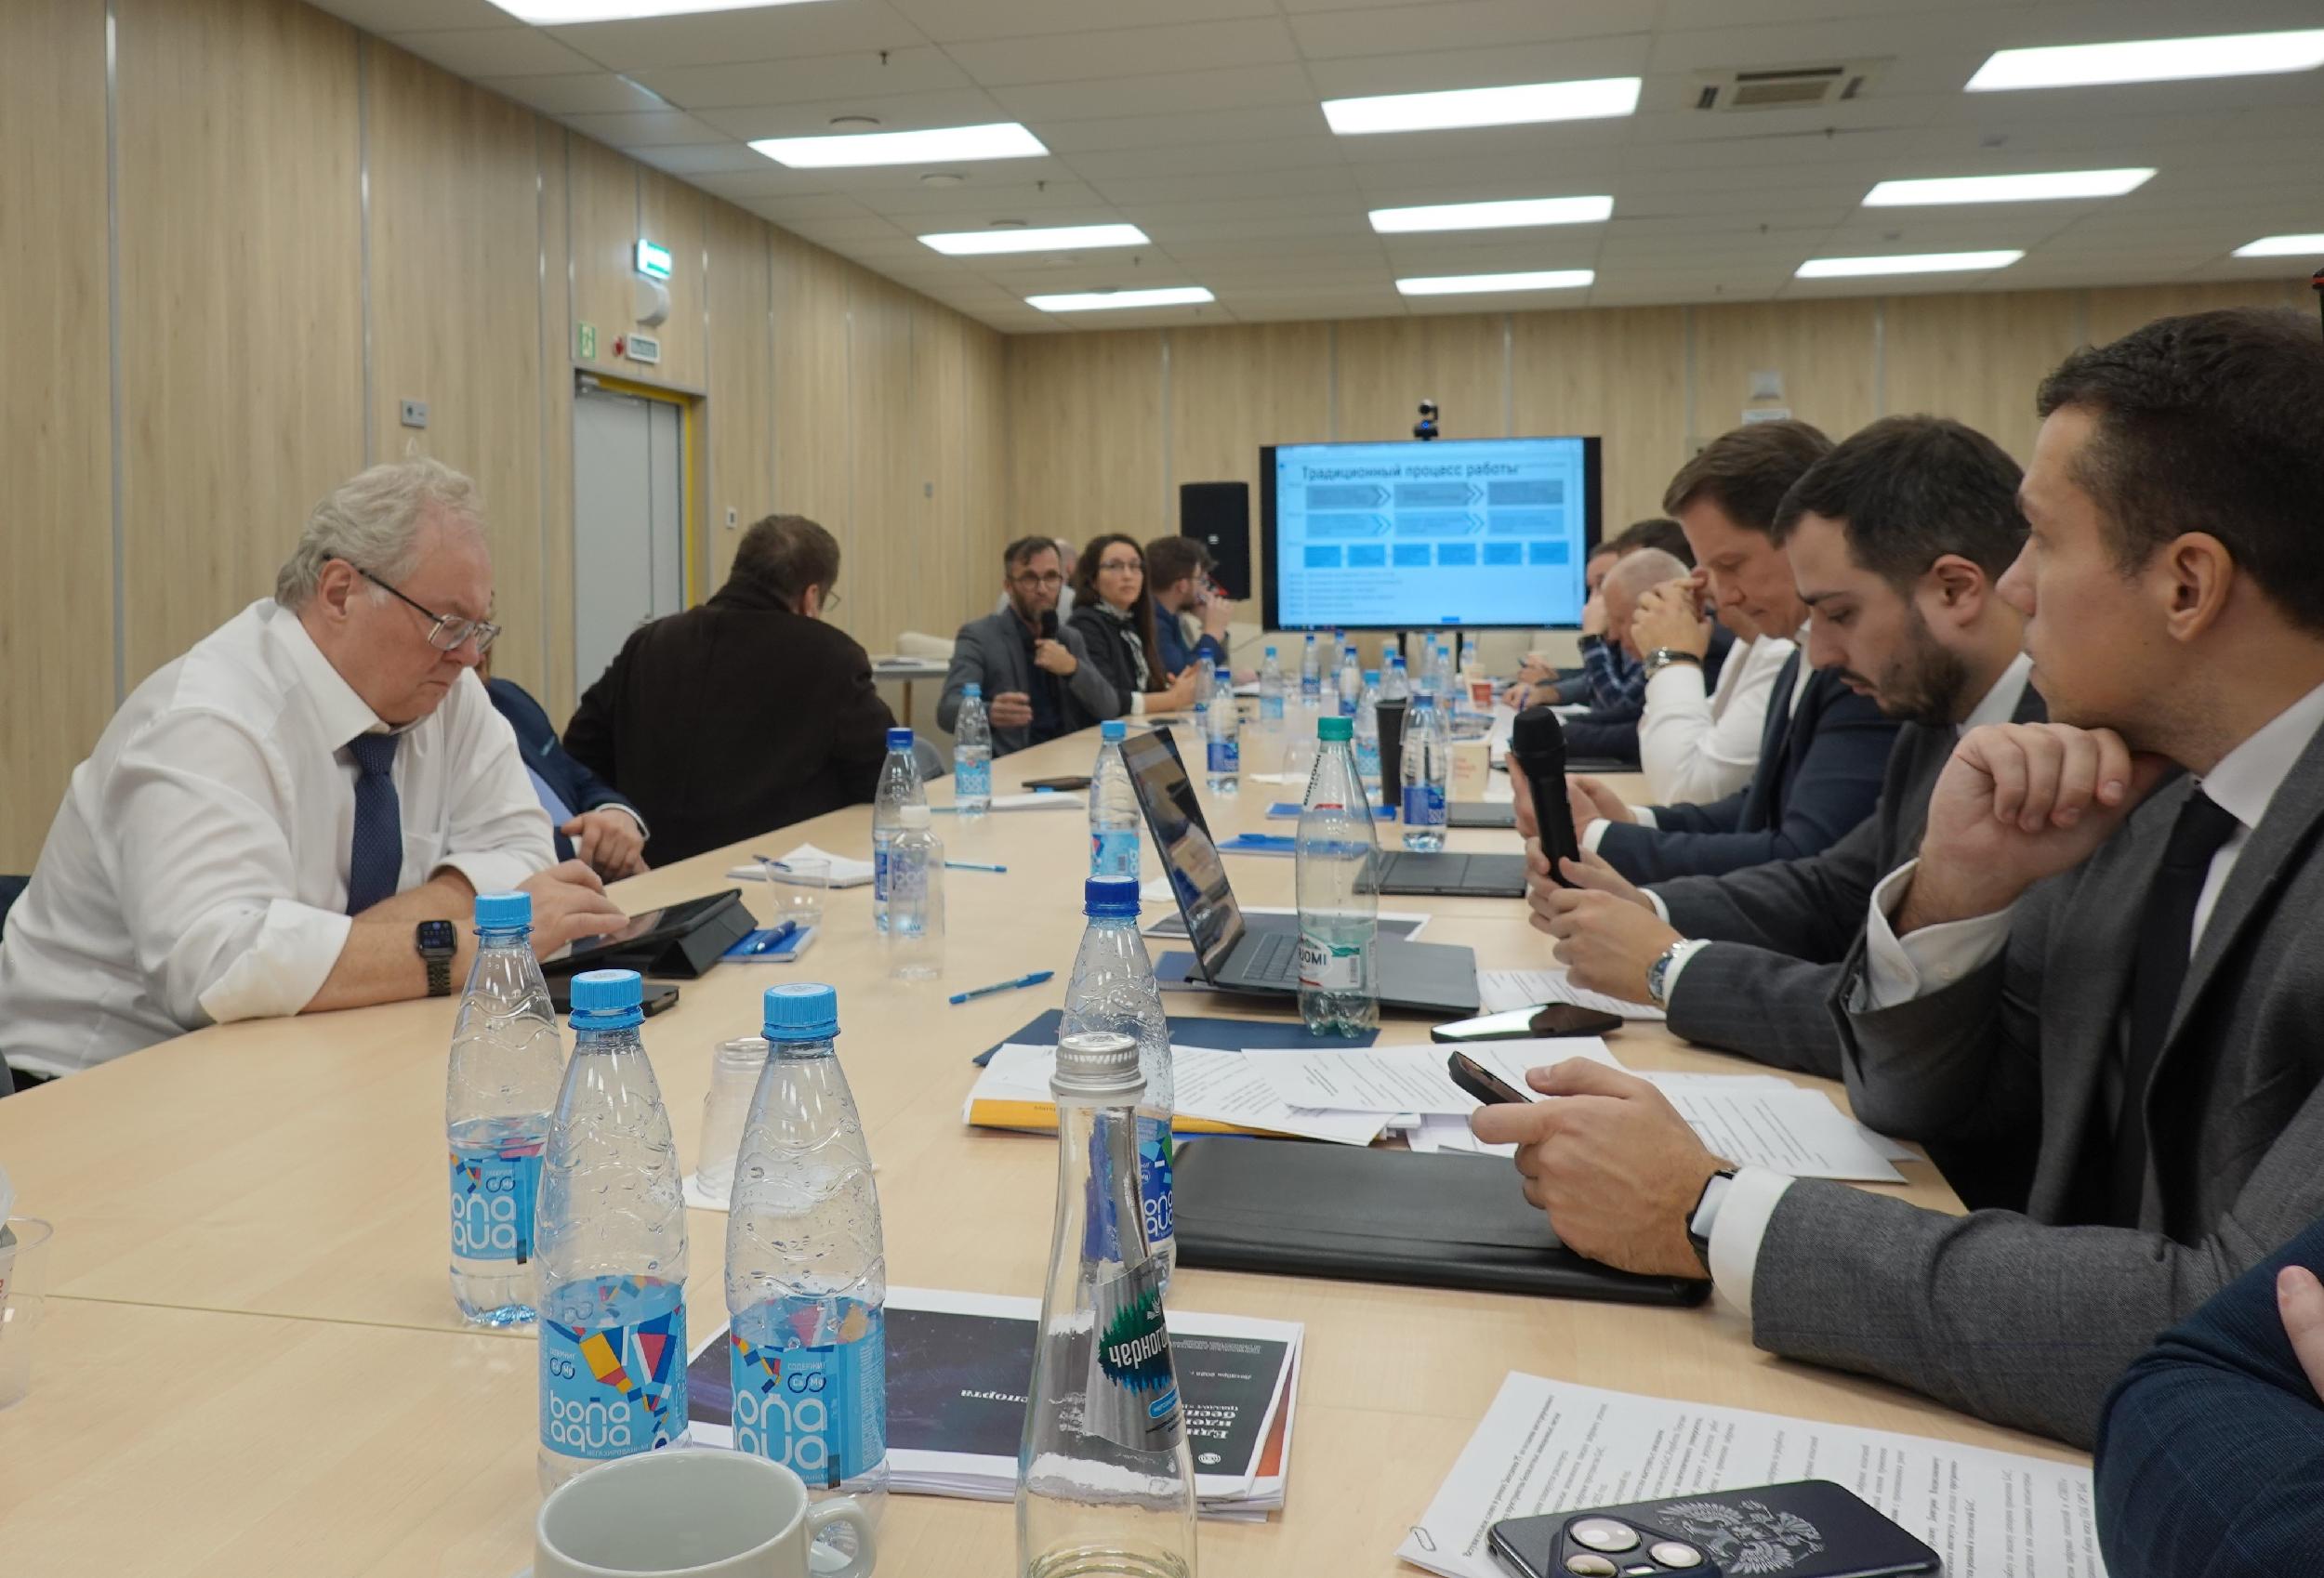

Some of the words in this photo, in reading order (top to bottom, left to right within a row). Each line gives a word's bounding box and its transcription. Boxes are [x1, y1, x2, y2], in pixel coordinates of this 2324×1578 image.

[1302, 466, 1401, 480] Традиционный
[1405, 465, 1461, 480] процесс
[1465, 463, 1519, 478] работы
[550, 1420, 631, 1453] aqua
